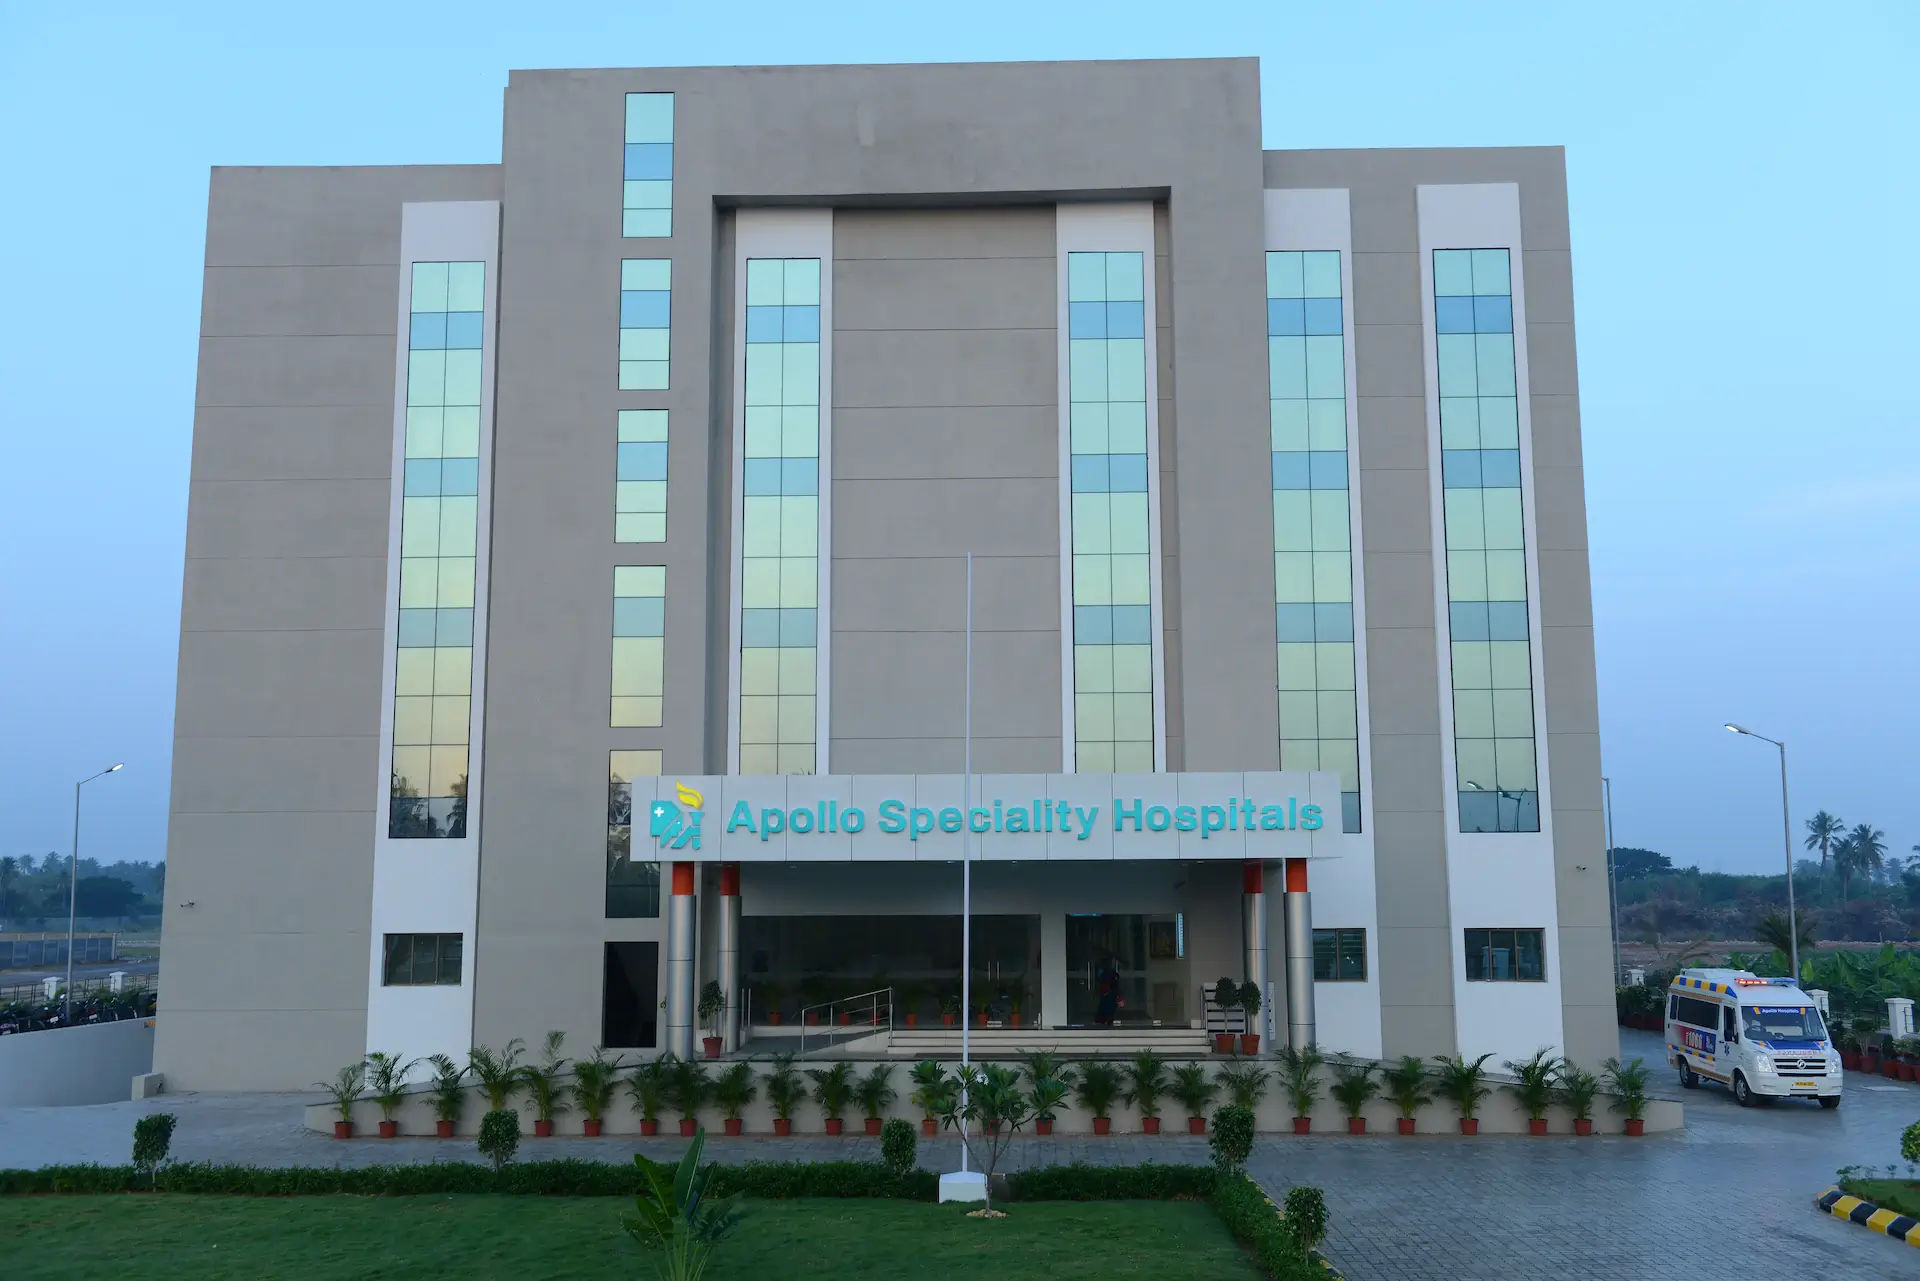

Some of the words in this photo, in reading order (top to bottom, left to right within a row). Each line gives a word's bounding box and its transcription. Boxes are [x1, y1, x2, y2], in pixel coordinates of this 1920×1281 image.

[727, 799, 865, 841] Apollo
[879, 799, 1099, 841] Speciality
[1113, 797, 1324, 840] Hospitals
